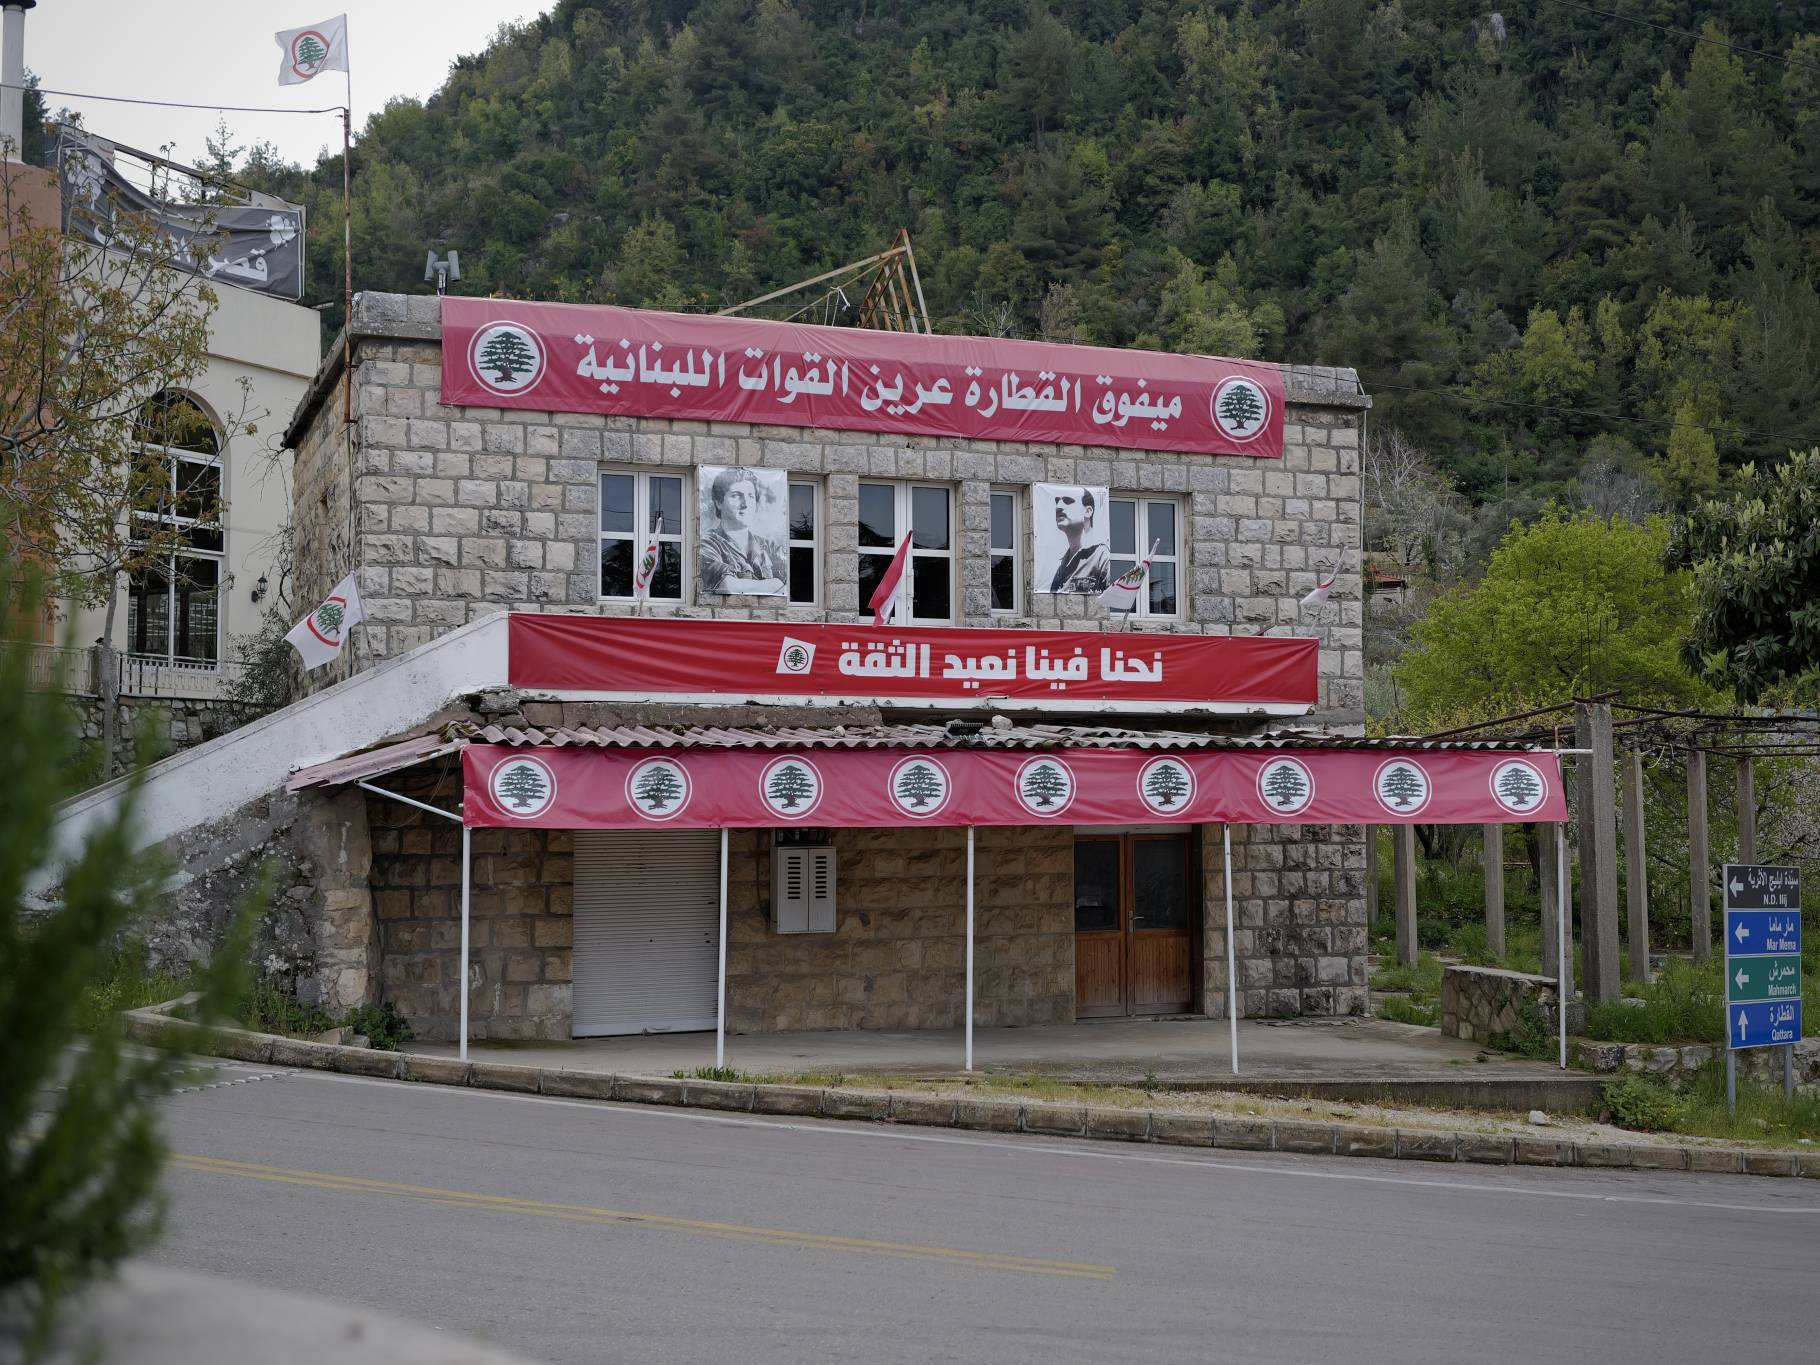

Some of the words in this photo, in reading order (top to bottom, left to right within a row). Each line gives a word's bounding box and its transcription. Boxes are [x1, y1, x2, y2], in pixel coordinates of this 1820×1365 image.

[575, 333, 725, 396] اللبنانية
[738, 346, 849, 404] القوات
[860, 364, 954, 415] عرين
[965, 365, 1081, 418] القطارة
[1092, 374, 1183, 431] ميفوق
[838, 639, 930, 678] الثقة
[943, 647, 1017, 689] نعيد
[1025, 645, 1089, 690] فينا
[1100, 646, 1163, 683] نحنا
[1763, 894, 1778, 905] N.D.
[1779, 894, 1788, 907] Ilij
[1768, 916, 1782, 932] ماما
[1782, 916, 1794, 937] مار
[1766, 938, 1778, 951] Mar
[1779, 938, 1796, 951] Mema
[1768, 961, 1795, 981] محمرش
[1768, 984, 1796, 996] Mahmarch
[1769, 1004, 1795, 1026] القطارة
[1771, 1028, 1793, 1041] Qattara
